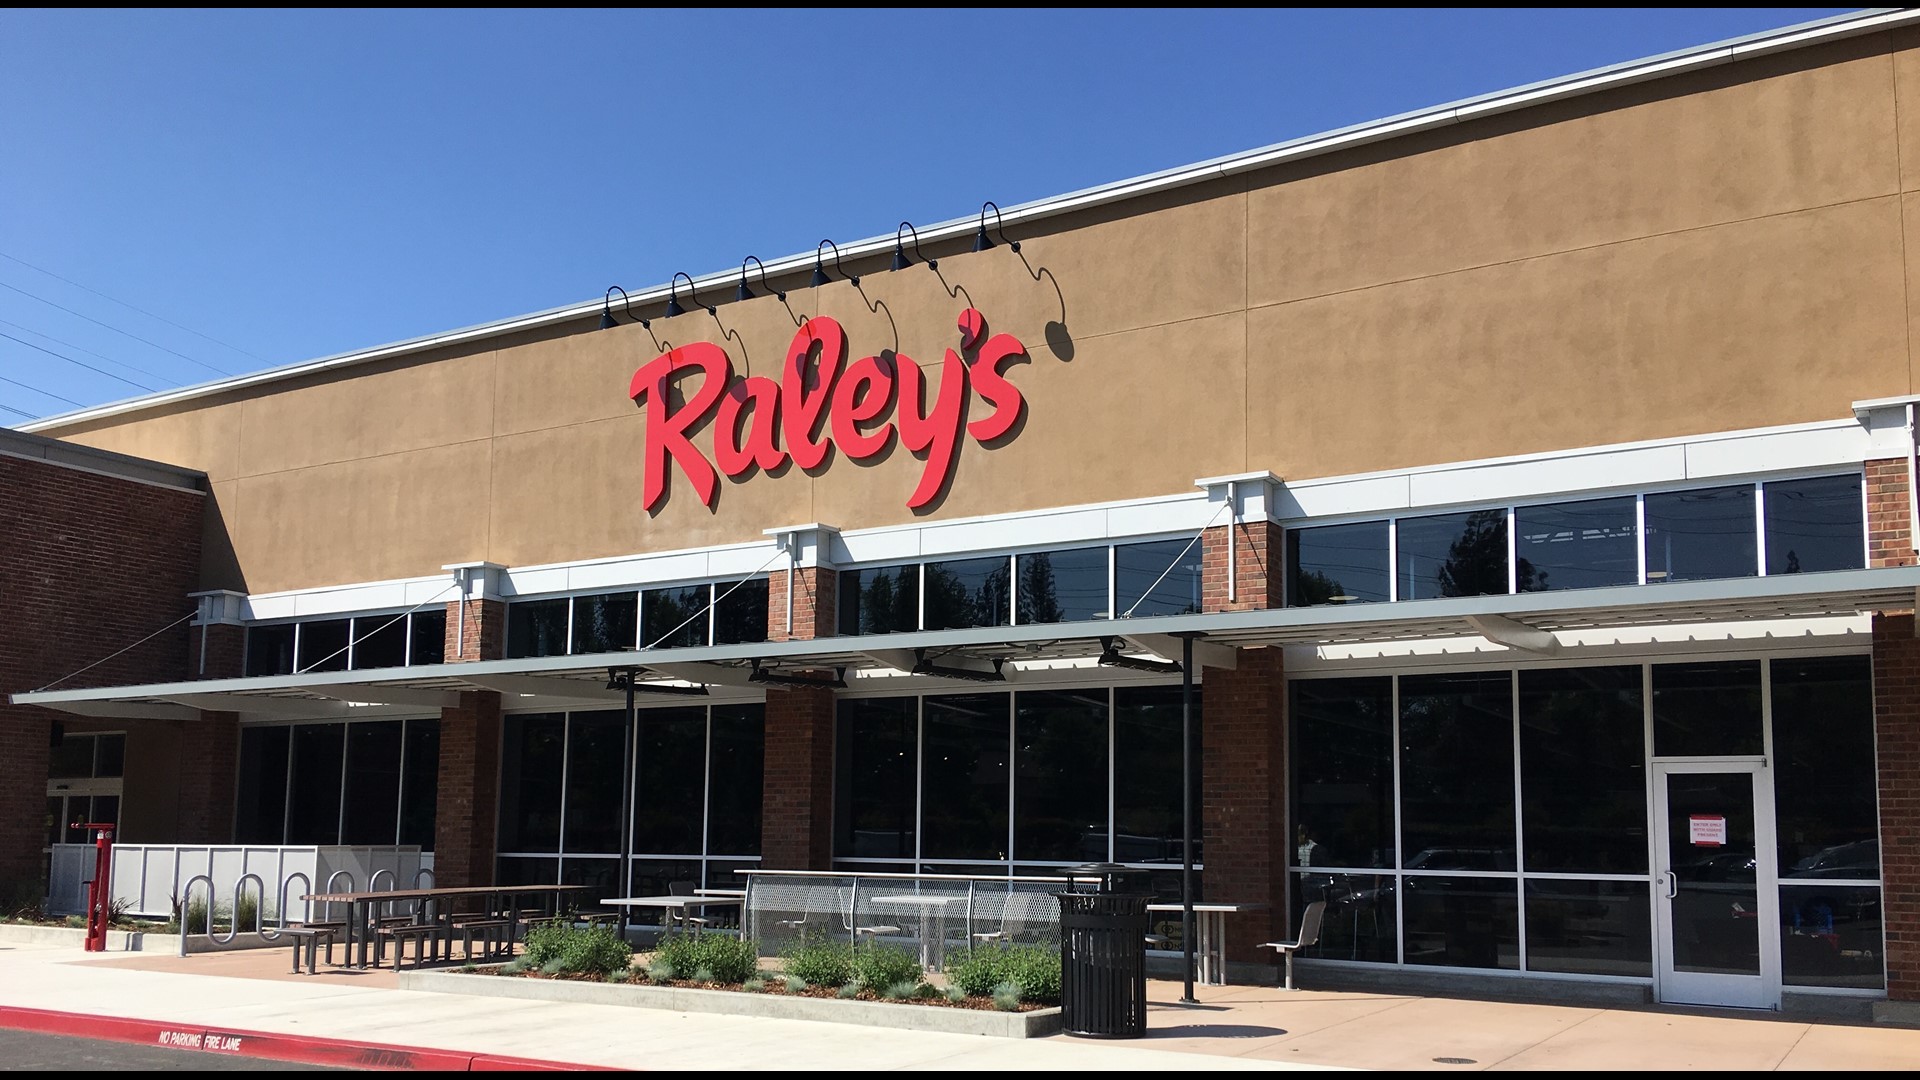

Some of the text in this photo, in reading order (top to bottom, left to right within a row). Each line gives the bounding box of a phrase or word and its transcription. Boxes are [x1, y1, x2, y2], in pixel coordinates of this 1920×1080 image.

[630, 308, 1026, 510] Raley's
[159, 1031, 241, 1051] NO PARKING FIRE LANE
